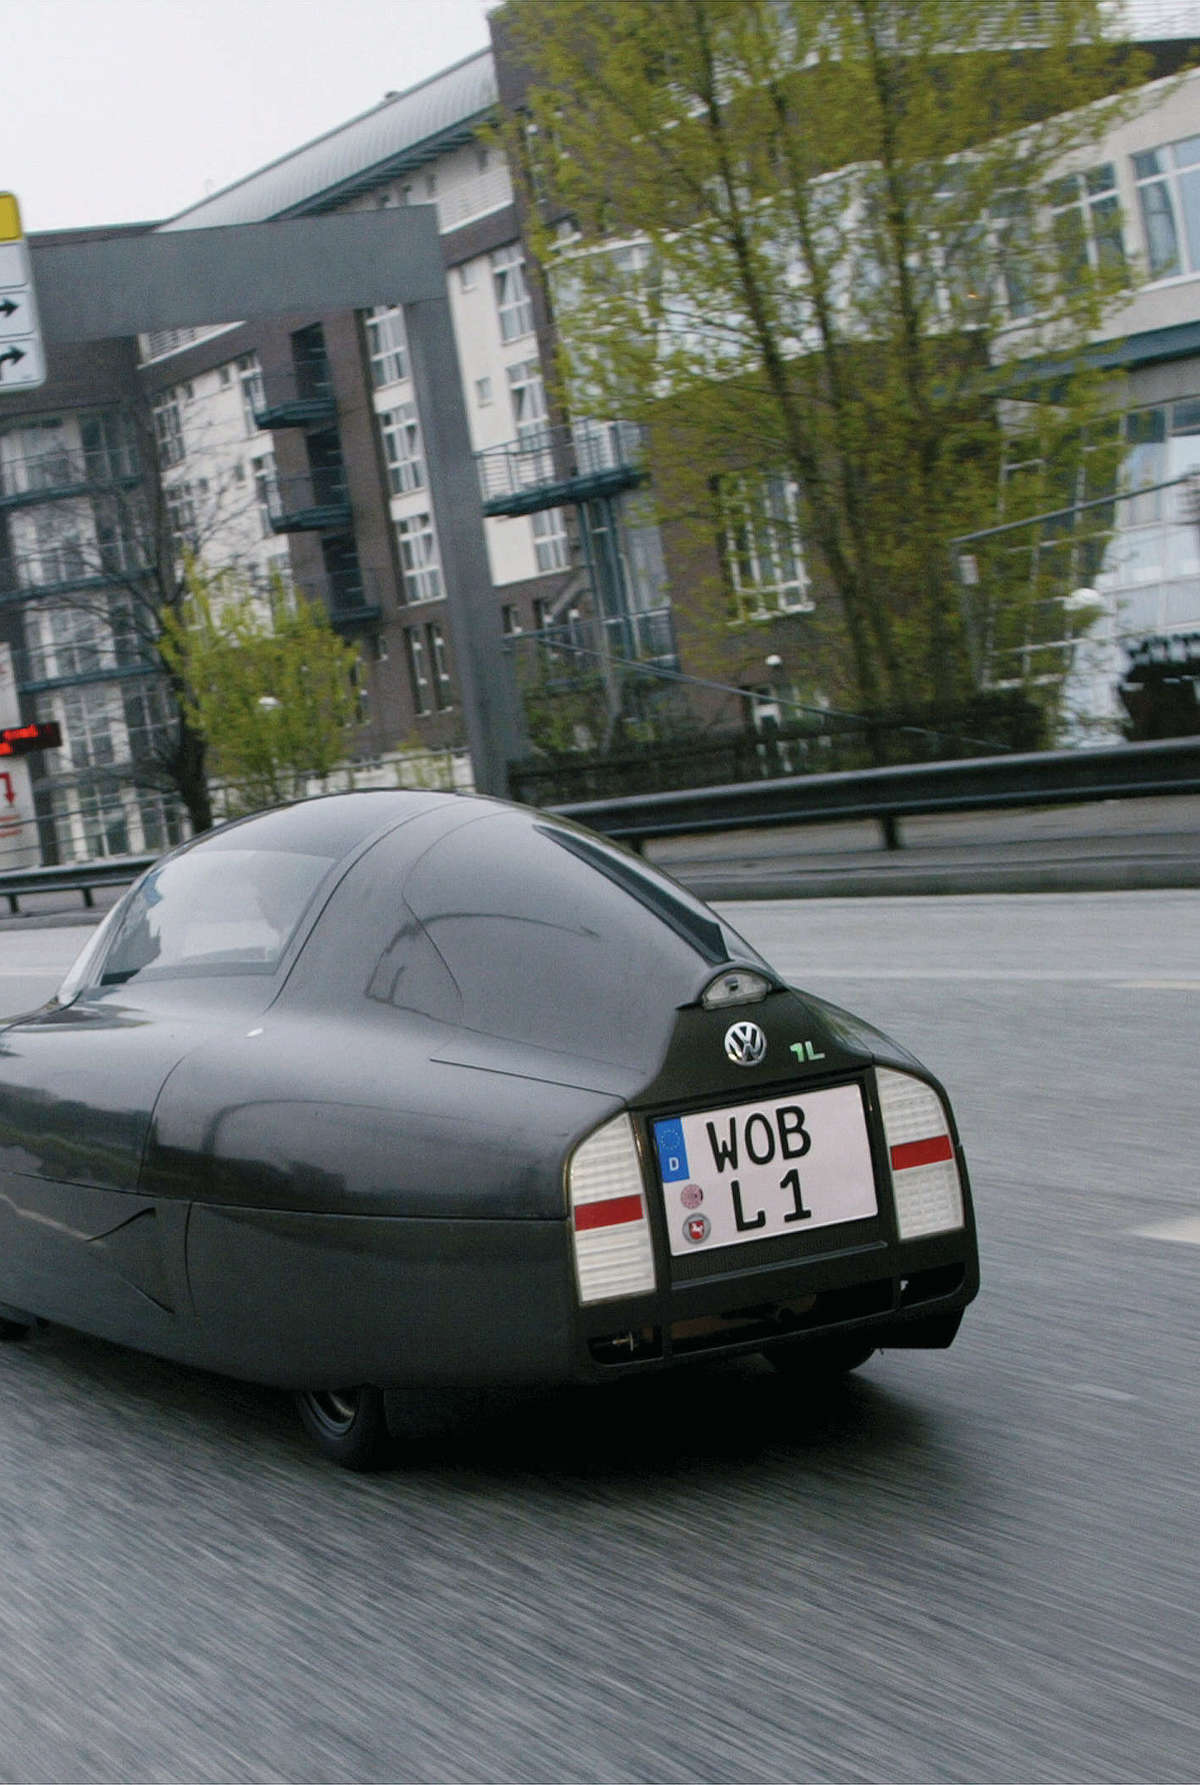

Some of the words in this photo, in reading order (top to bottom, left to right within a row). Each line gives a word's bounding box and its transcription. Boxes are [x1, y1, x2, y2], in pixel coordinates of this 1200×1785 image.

[790, 1041, 826, 1063] 1L
[706, 1105, 812, 1174] WOB
[668, 1156, 680, 1172] D
